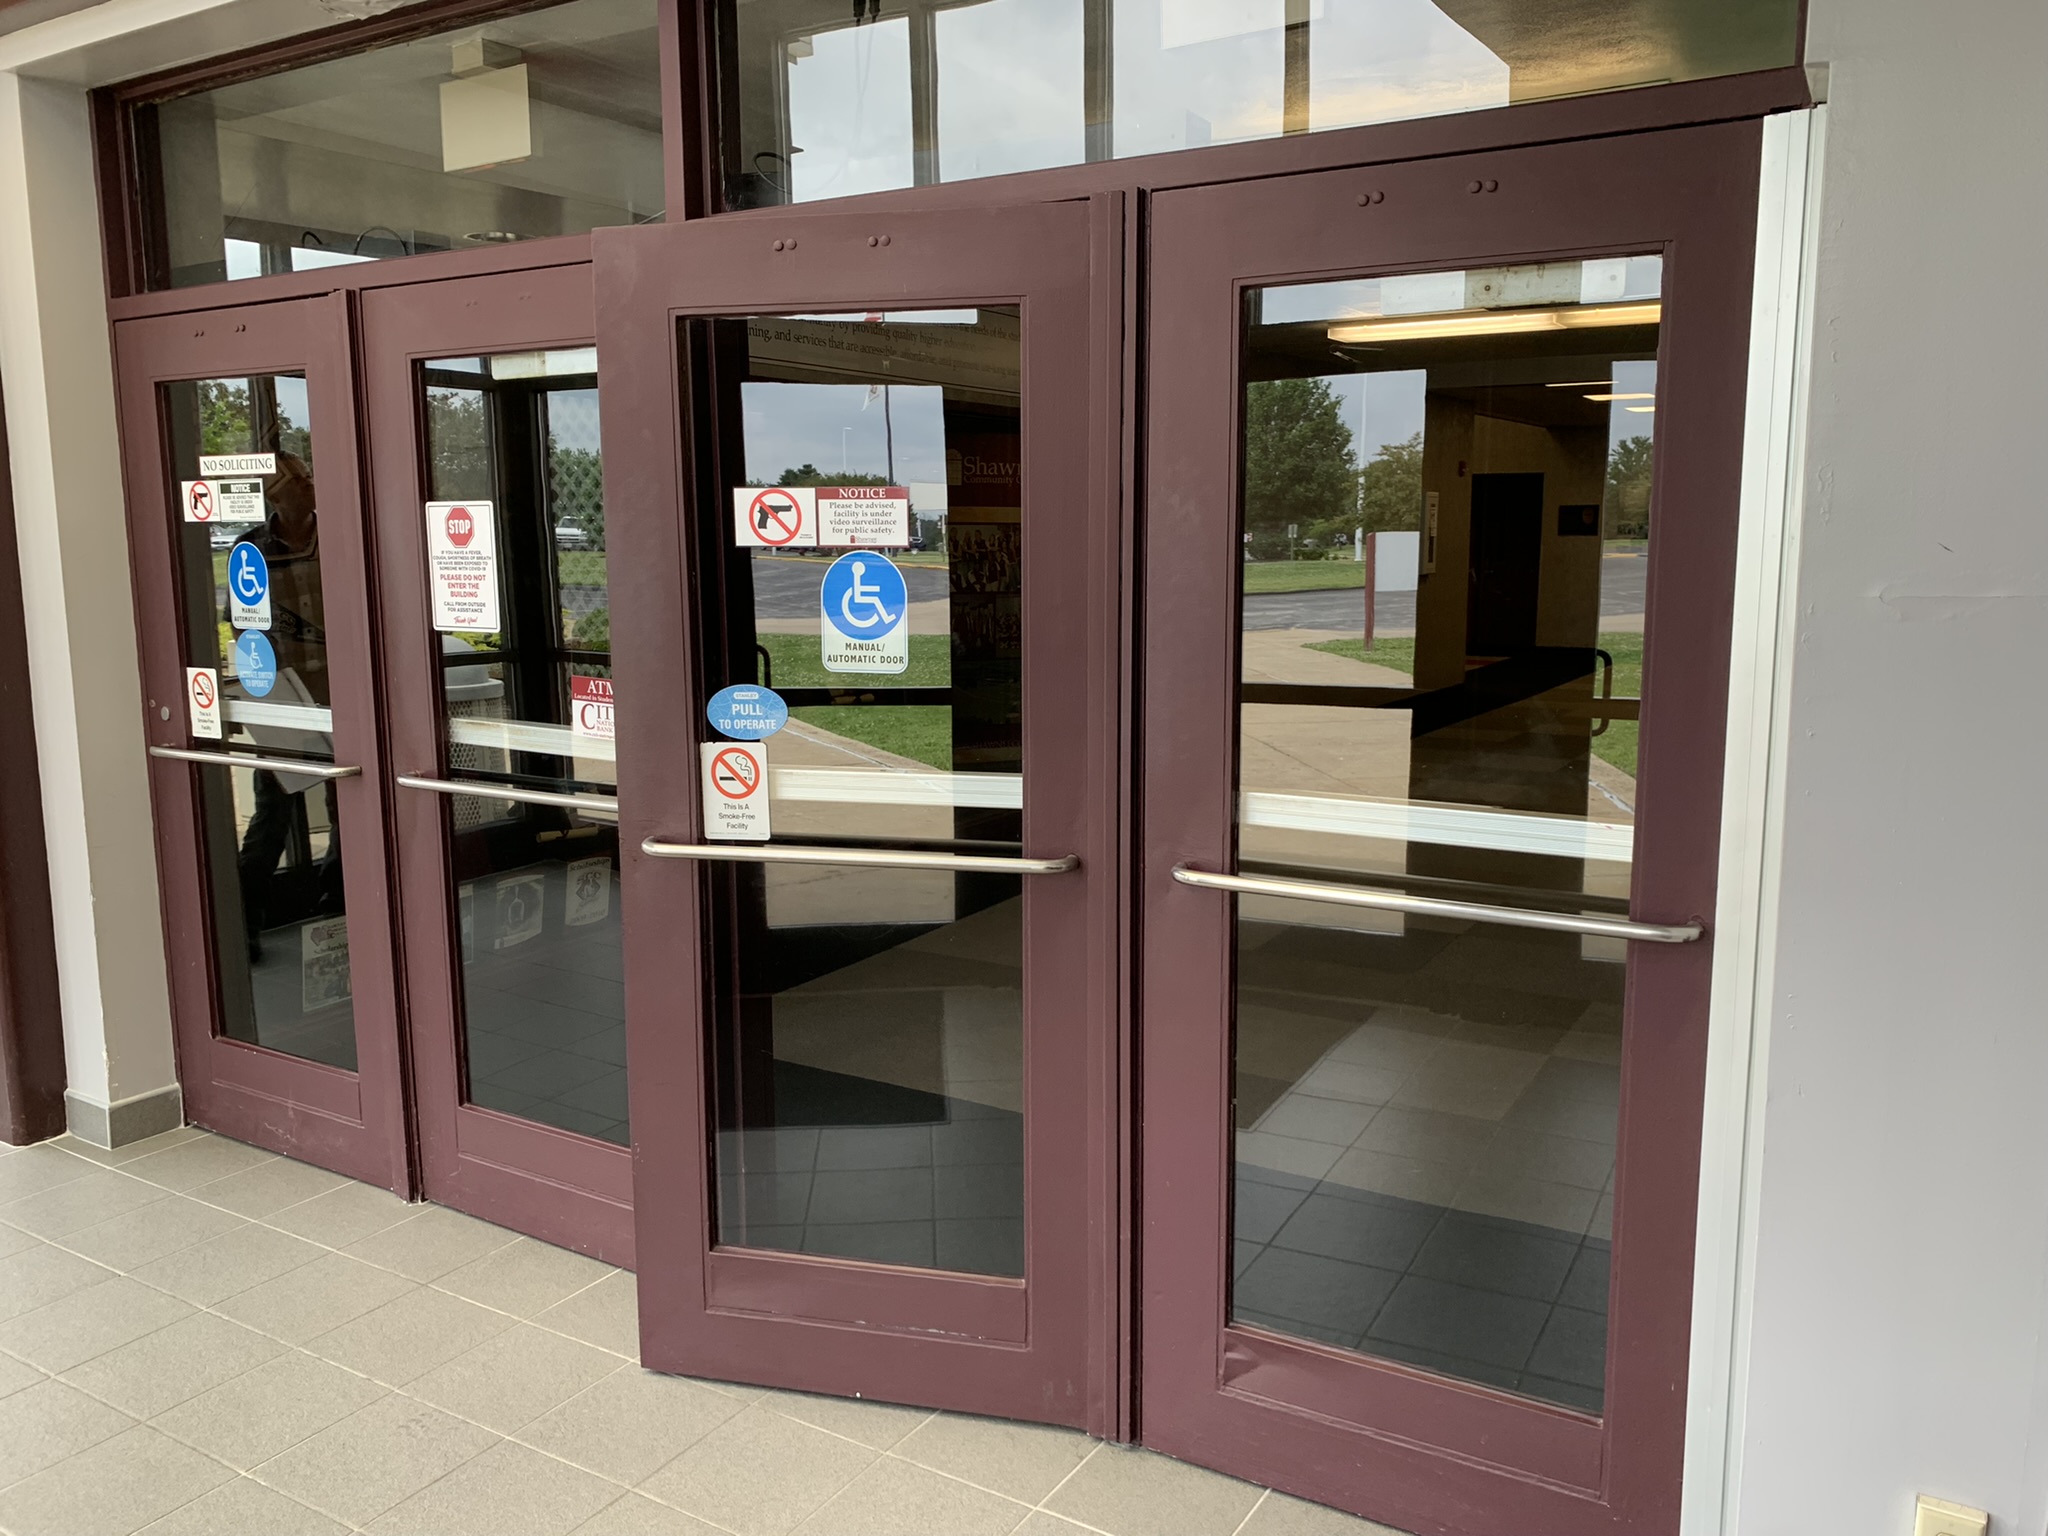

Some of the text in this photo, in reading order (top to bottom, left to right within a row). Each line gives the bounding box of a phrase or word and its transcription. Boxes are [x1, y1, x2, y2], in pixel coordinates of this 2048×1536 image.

[852, 322, 890, 341] providing
[892, 328, 918, 346] quality
[920, 330, 942, 348] higher
[774, 329, 792, 342] and
[793, 333, 828, 348] services
[828, 336, 845, 350] that
[846, 341, 859, 353] are
[202, 457, 273, 472] NO SOLICITING
[963, 476, 1014, 488] Community
[230, 484, 251, 493] NOTICE
[838, 488, 886, 498] NOTICE
[864, 502, 896, 510] advised,
[834, 510, 860, 519] facility
[448, 520, 471, 534] STOP
[844, 526, 869, 535] public
[870, 527, 895, 535] safety.
[845, 643, 886, 652] MANUAL/
[827, 654, 904, 664] AUTOMATIC DOOR
[732, 703, 763, 716] PULL
[719, 719, 777, 730] TO OPERATE
